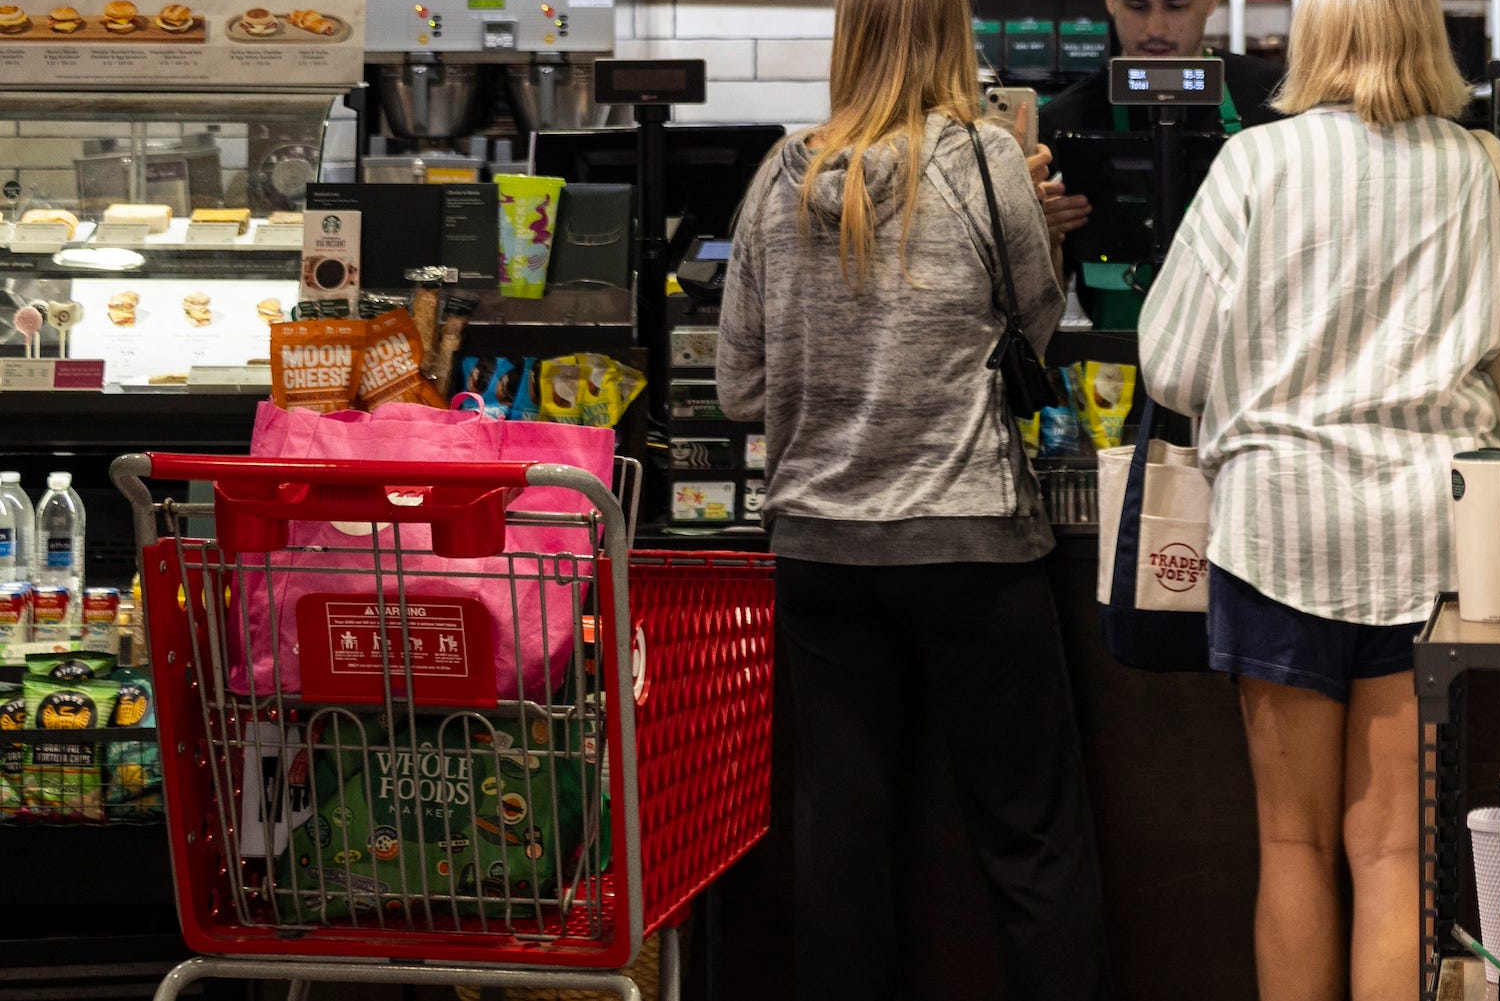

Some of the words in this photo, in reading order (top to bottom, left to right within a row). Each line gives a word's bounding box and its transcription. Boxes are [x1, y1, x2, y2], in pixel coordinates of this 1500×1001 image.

[1128, 79, 1149, 90] Total
[282, 344, 353, 369] MOON
[283, 367, 353, 389] CHEESE
[1150, 553, 1208, 572] TRADER
[1155, 567, 1199, 584] JOE'S
[86, 609, 115, 617] HORIZON
[54, 694, 86, 706] SIETE
[376, 751, 475, 780] WHOLE
[379, 776, 471, 806] FOODS
